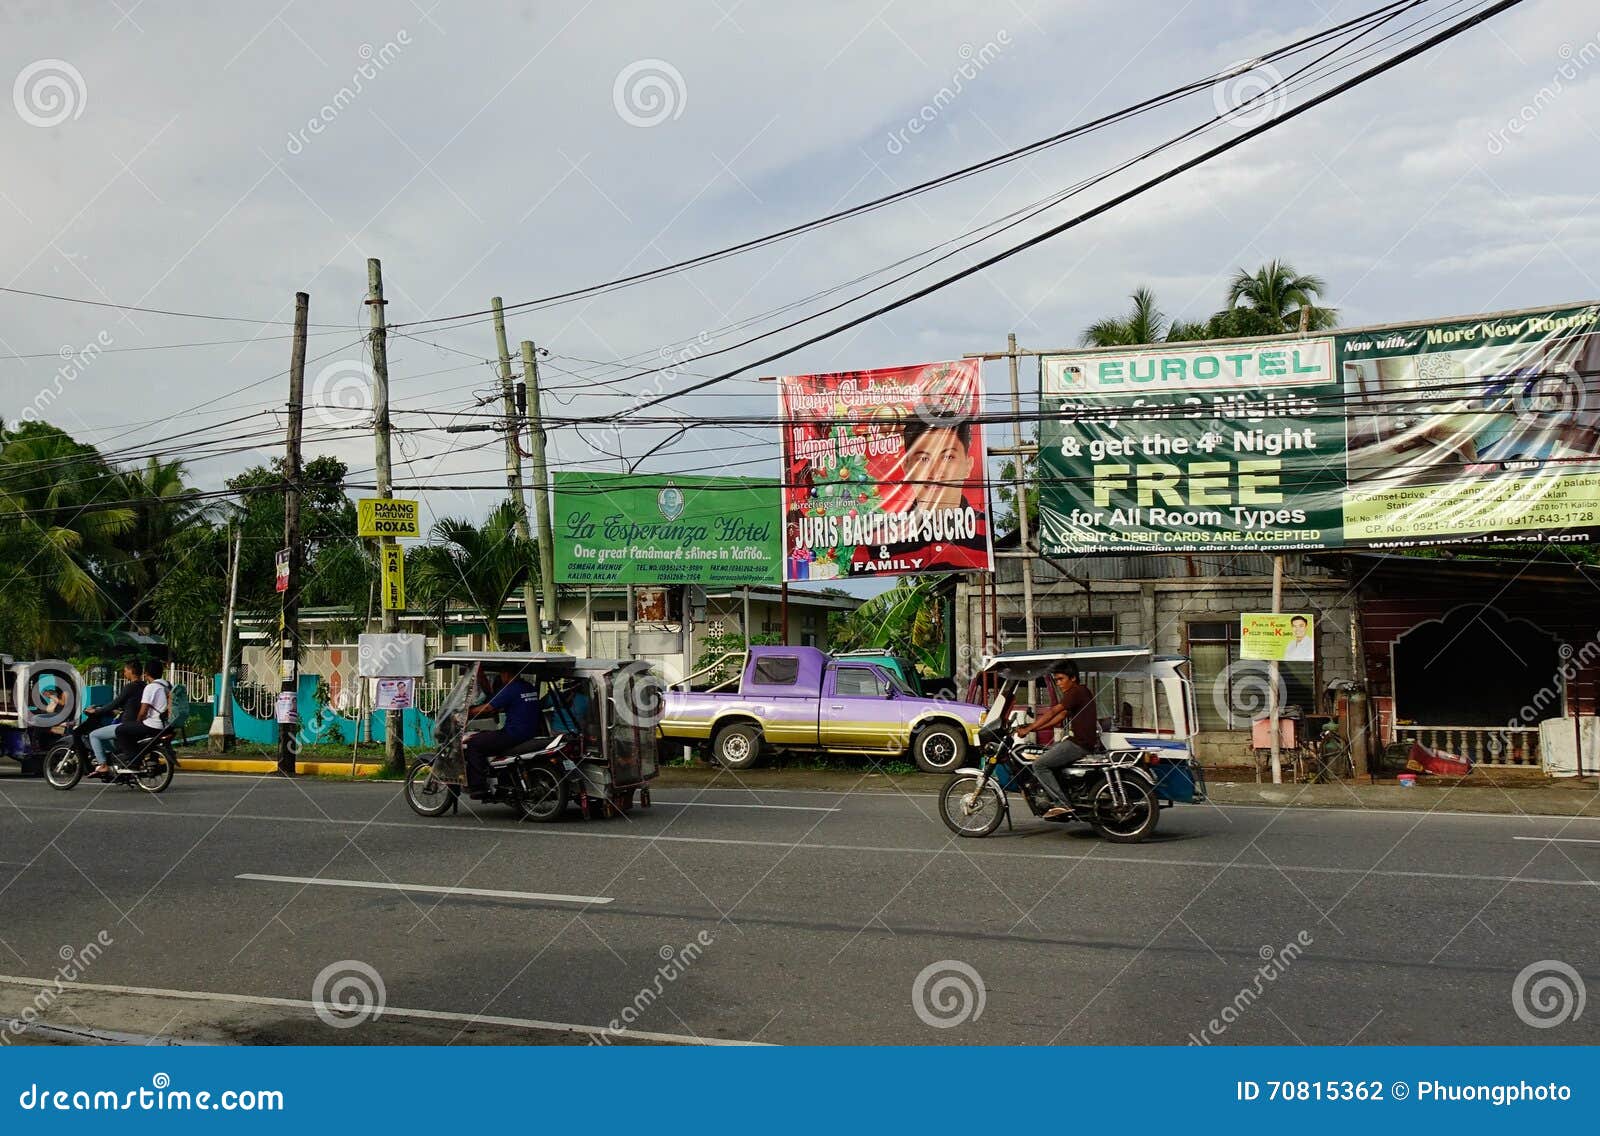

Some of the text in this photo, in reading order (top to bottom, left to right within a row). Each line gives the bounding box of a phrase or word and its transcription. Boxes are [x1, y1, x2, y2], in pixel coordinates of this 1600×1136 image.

[1344, 341, 1373, 352] Now
[1426, 328, 1475, 345] More
[1481, 323, 1520, 339] New
[1528, 312, 1598, 334] Rooms
[1098, 349, 1322, 385] EUROTEL
[789, 379, 920, 415] Merry Christmas
[1213, 393, 1319, 423] Nights
[793, 424, 902, 469] Happy New Year
[1061, 436, 1082, 457] &
[1089, 436, 1137, 461] get
[1142, 433, 1189, 456] the
[1233, 427, 1317, 456] Night
[1093, 459, 1283, 507] FREE
[375, 503, 413, 512] DAANG
[1070, 505, 1306, 530] for All Room Types
[375, 521, 415, 532] ROXAS
[564, 511, 770, 548] La Esperanza Hotel
[796, 506, 976, 548] JURIS BAUTISTA SUCRO
[1061, 529, 1321, 542] CREDIT & DEBIT CARDS ARE ACCEPTED
[1365, 524, 1383, 534] CP.
[574, 544, 596, 559] One
[598, 545, 627, 563] great
[630, 545, 682, 560] landmark
[684, 545, 718, 560] shines
[719, 546, 729, 560] in
[879, 545, 890, 559] &
[1054, 545, 1071, 554] Not
[1073, 544, 1099, 553] valid
[1100, 544, 1109, 552] in
[1174, 544, 1197, 552] with
[1199, 543, 1228, 551] other
[1230, 543, 1258, 551] hotel
[1261, 542, 1325, 551] promotions
[388, 552, 398, 572] MAR
[596, 563, 623, 571] AVENUE
[853, 558, 923, 571] FAMILY
[390, 582, 398, 608] LENI
